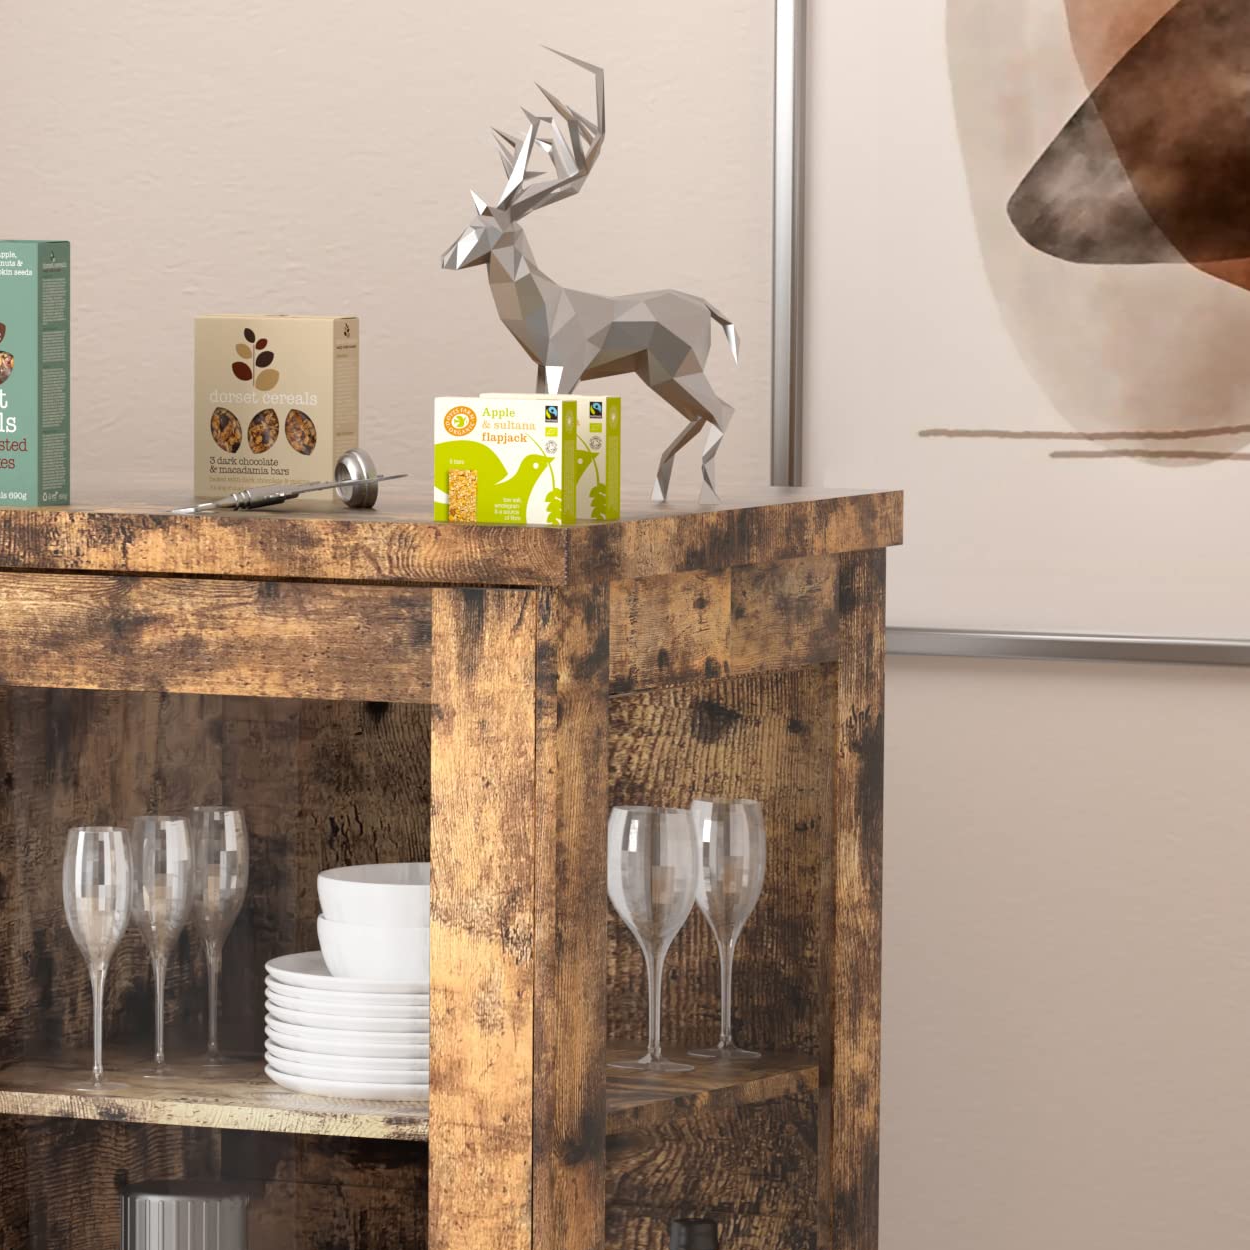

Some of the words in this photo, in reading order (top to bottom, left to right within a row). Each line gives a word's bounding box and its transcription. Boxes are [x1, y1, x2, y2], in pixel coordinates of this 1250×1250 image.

[210, 389, 258, 404] dorset
[262, 392, 318, 406] cereals
[482, 407, 516, 419] Apple
[482, 420, 490, 429] &
[493, 420, 536, 430] sultana
[481, 432, 527, 444] flapjack
[209, 456, 216, 465] 3
[217, 457, 237, 465] dark
[238, 458, 279, 467] chocolate
[209, 466, 217, 474] &
[219, 466, 269, 475] macadamia
[270, 467, 290, 476] bars
